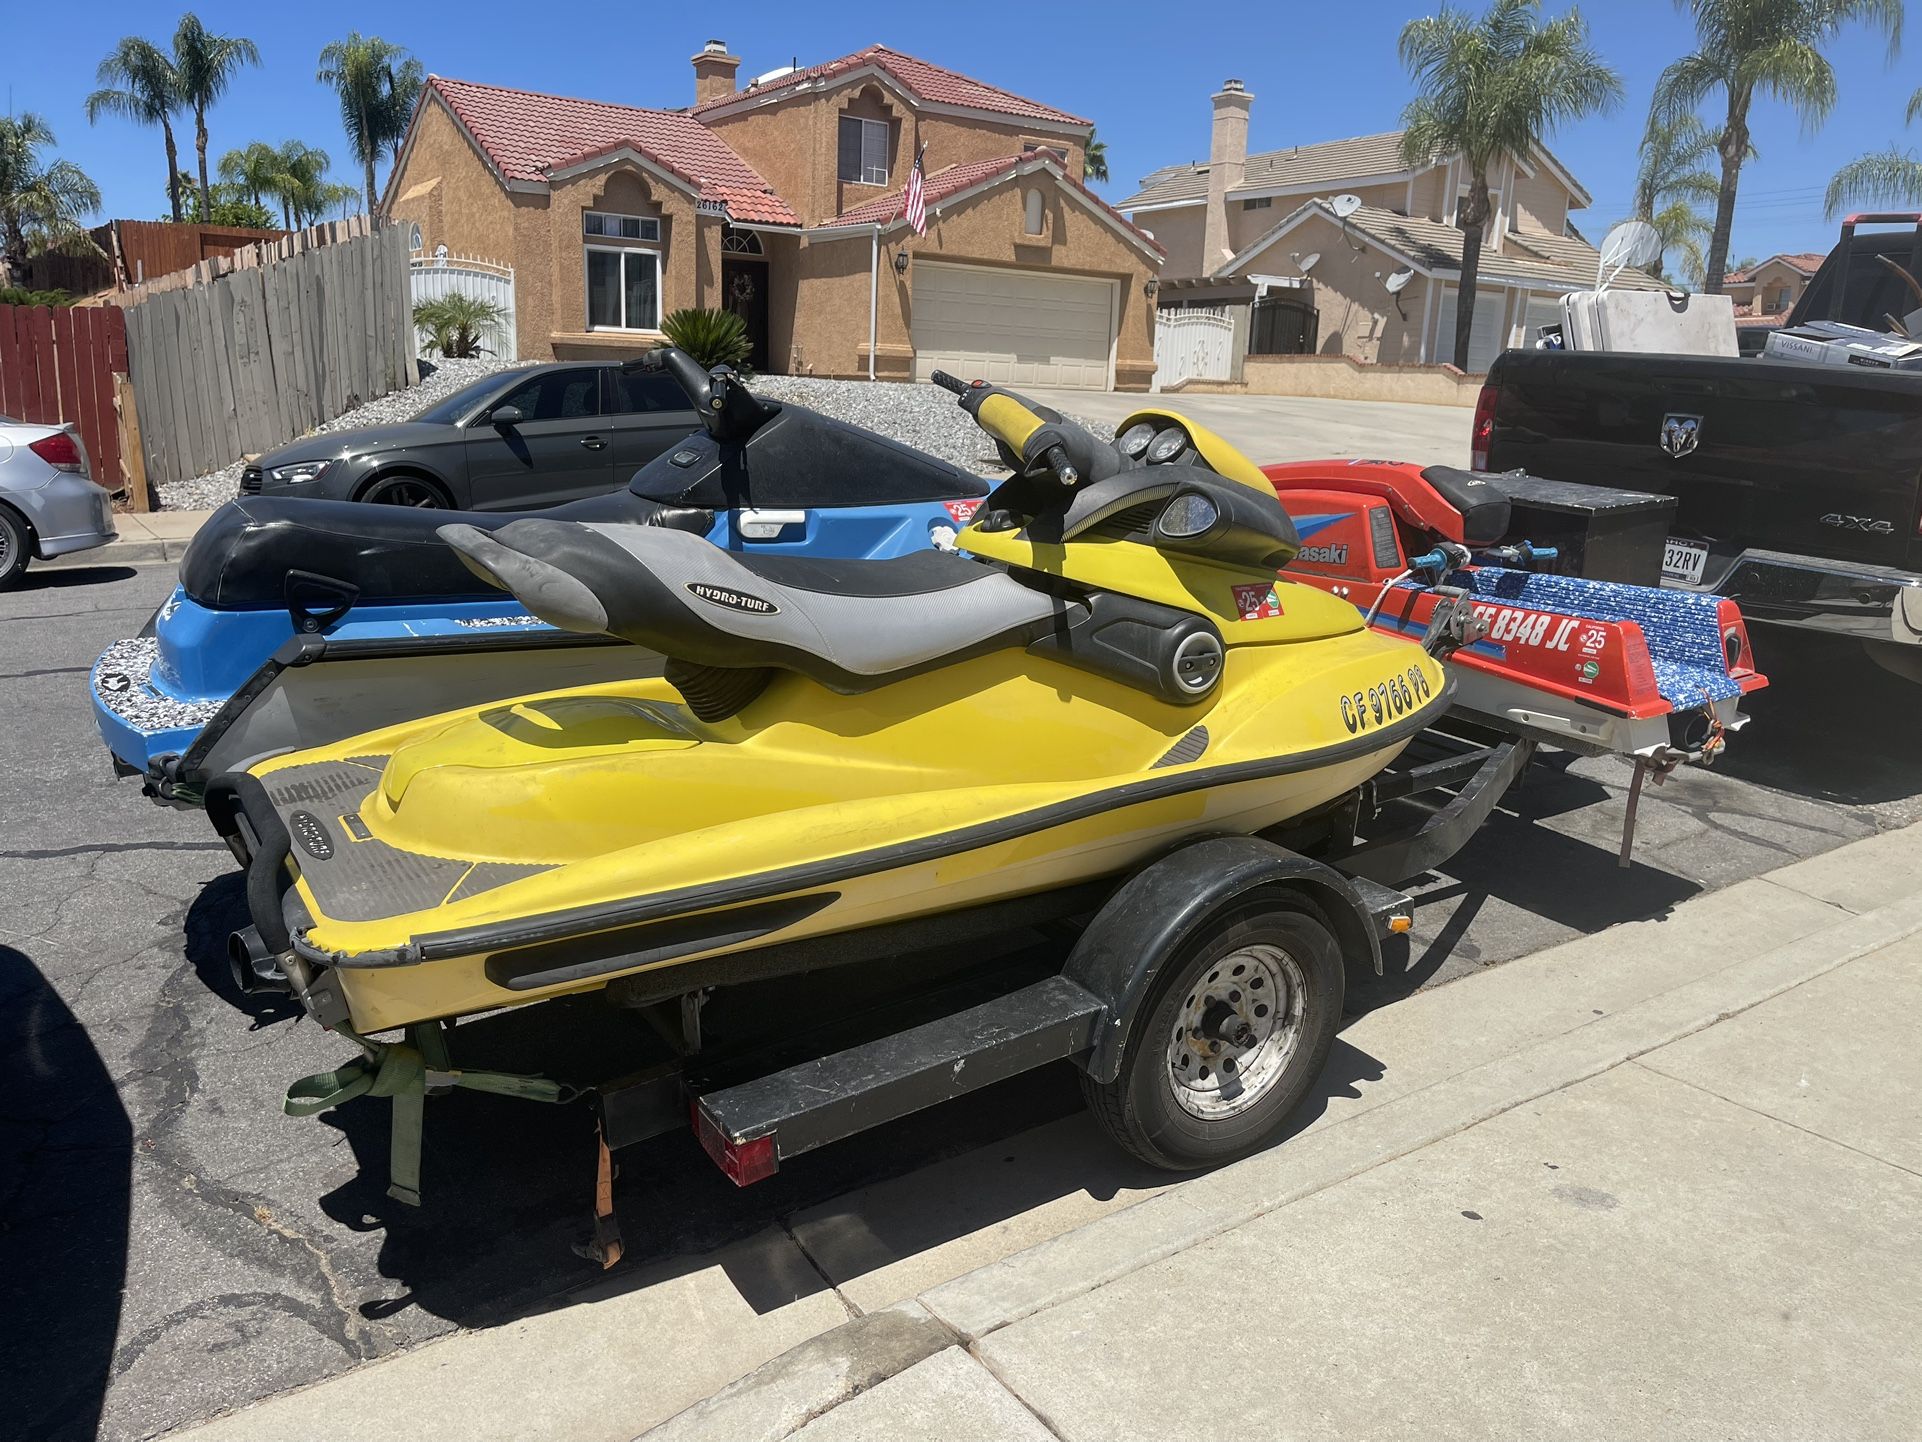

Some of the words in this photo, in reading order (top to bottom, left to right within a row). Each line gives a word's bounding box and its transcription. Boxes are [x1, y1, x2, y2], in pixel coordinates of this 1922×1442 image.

[696, 200, 724, 211] 26162
[1781, 340, 1813, 354] VISSANI
[952, 503, 971, 517] 25
[1294, 543, 1348, 565] asaki
[1665, 549, 1701, 571] 32RV
[696, 585, 769, 611] HYDRO-TURF
[1242, 591, 1260, 611] 25
[1490, 609, 1551, 646] 8348
[1545, 618, 1580, 651] JC
[1586, 629, 1607, 649] 25
[1341, 691, 1367, 734] CF
[1368, 674, 1413, 726] 9766
